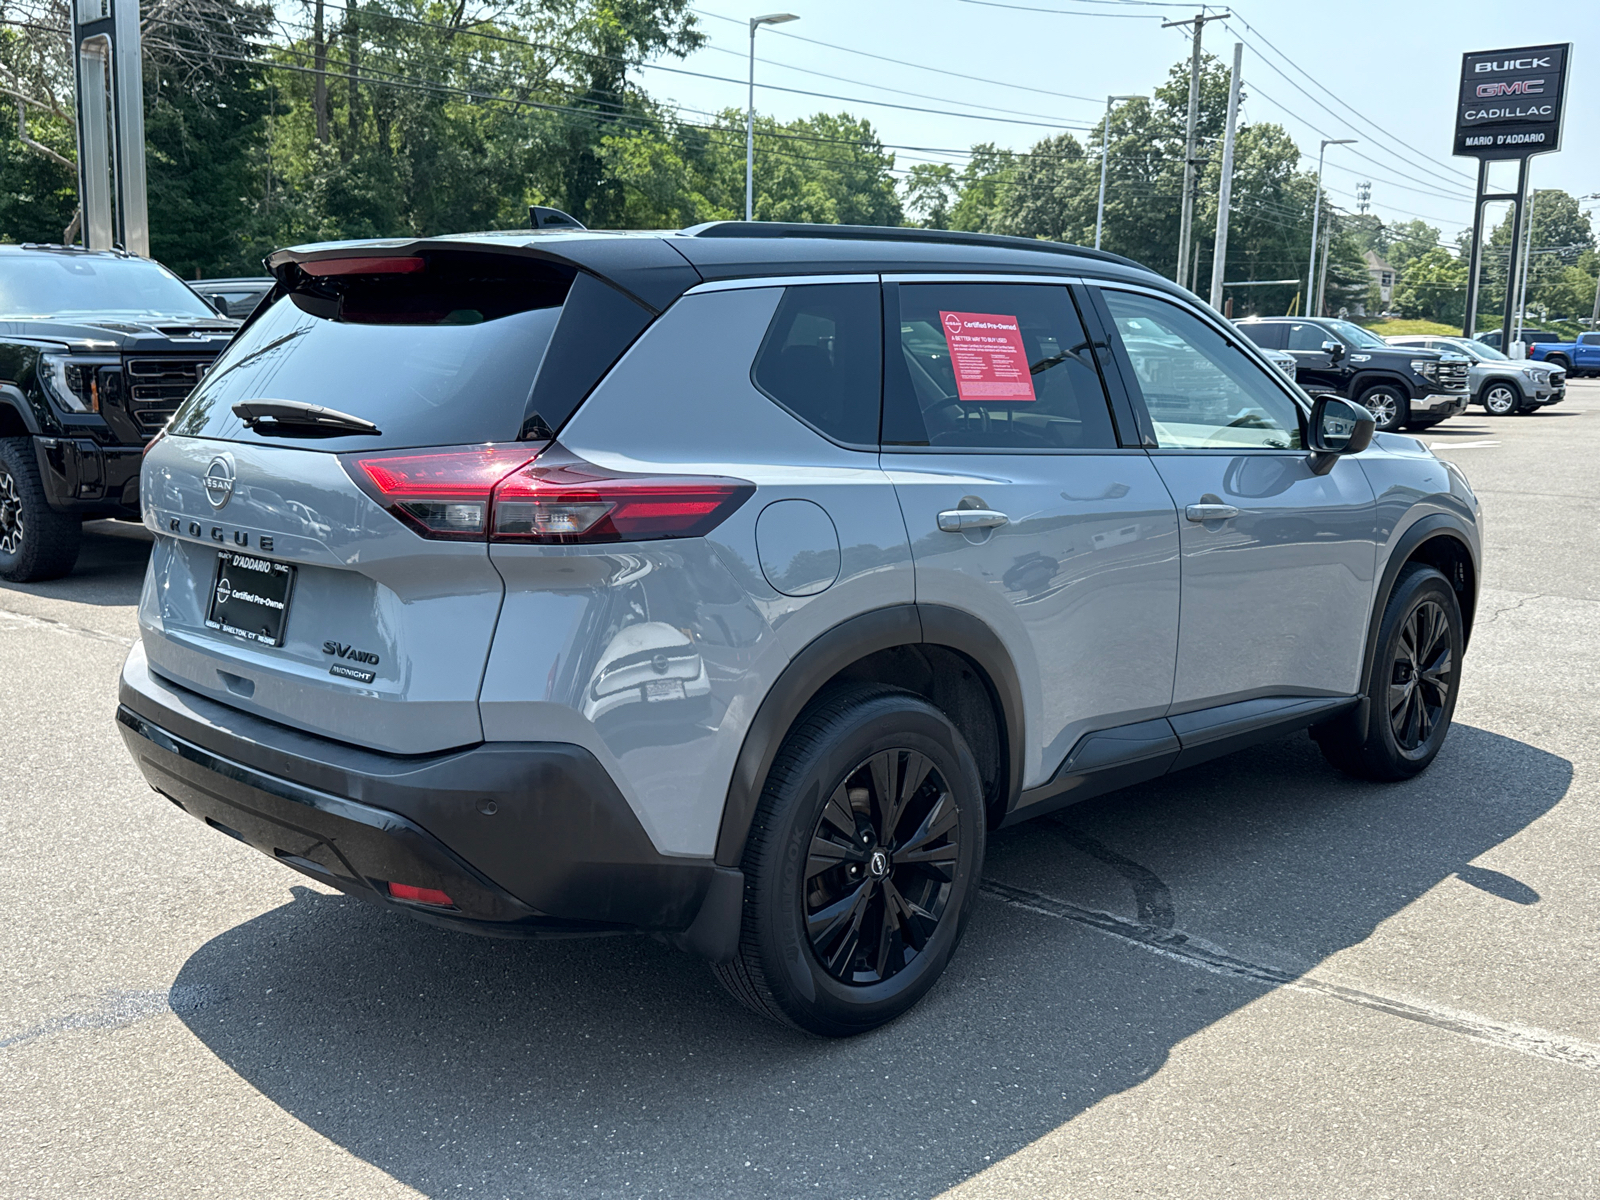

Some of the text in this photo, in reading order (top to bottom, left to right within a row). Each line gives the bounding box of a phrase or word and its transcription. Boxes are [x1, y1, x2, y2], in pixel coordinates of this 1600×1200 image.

[1474, 57, 1551, 73] BUICK
[1476, 79, 1545, 98] GMC
[1464, 105, 1552, 120] CADILLAC
[1465, 132, 1545, 146] MARIO D'ADDARIO
[963, 321, 1017, 331] Certified Pre-Owned
[169, 516, 274, 552] ROGUE
[232, 554, 271, 574] D'ADDARIO
[273, 563, 289, 573] GMC
[232, 589, 254, 603] Certified
[247, 632, 256, 640] CT
[332, 666, 371, 680] MIDNIGHT
